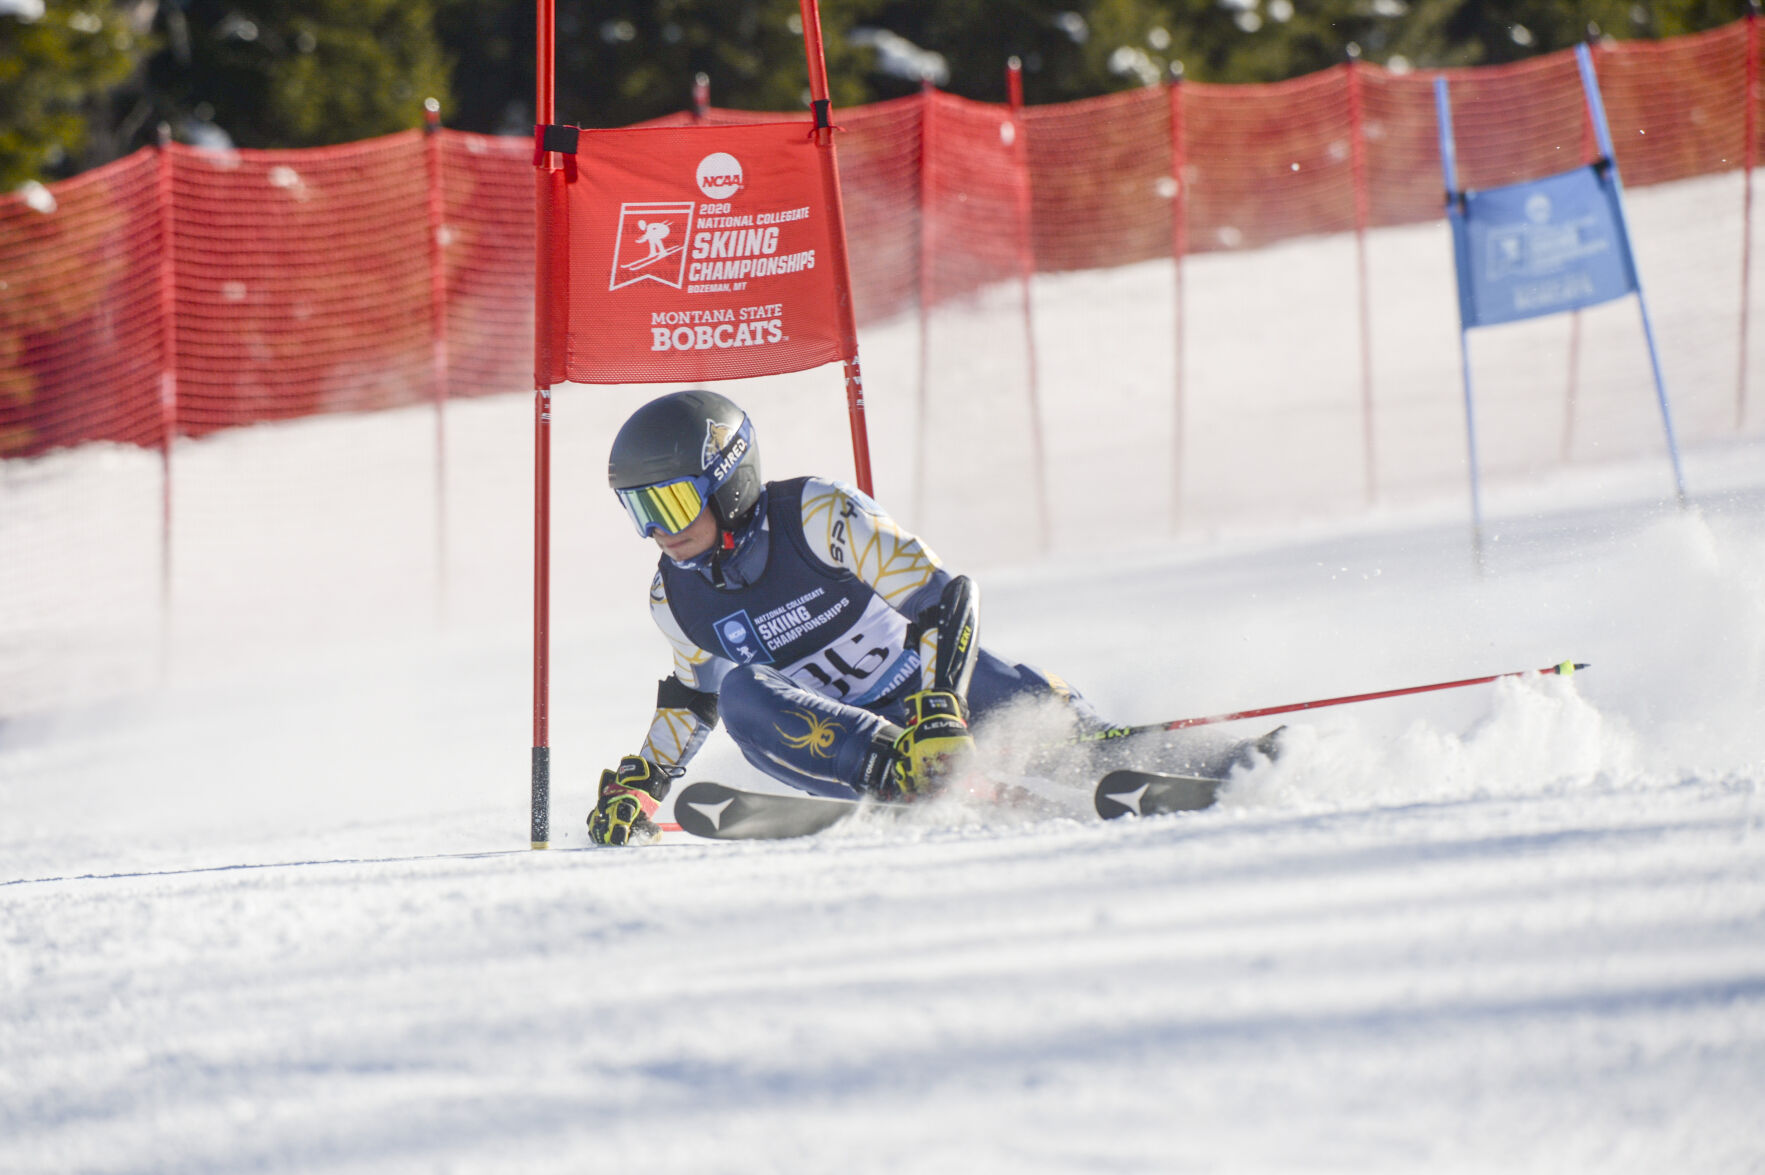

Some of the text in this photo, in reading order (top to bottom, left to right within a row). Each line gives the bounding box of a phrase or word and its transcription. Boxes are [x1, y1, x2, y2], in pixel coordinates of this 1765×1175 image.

[702, 174, 741, 188] NCAA
[697, 206, 810, 229] NATIONAL COLLEGIATE
[699, 203, 732, 215] 2020
[692, 227, 779, 259] SKIING
[689, 250, 815, 282] CHAMPIONSHIPS
[687, 282, 747, 293] BOZEMAN, MT
[651, 303, 782, 325] MONTANA STATE
[651, 319, 782, 351] BOBCATS
[754, 587, 825, 625] NATIONAL COLLEGIATE
[758, 605, 812, 641] SKIING
[767, 597, 850, 651] CHAMPIONSHIPS
[958, 625, 972, 654] LEKI
